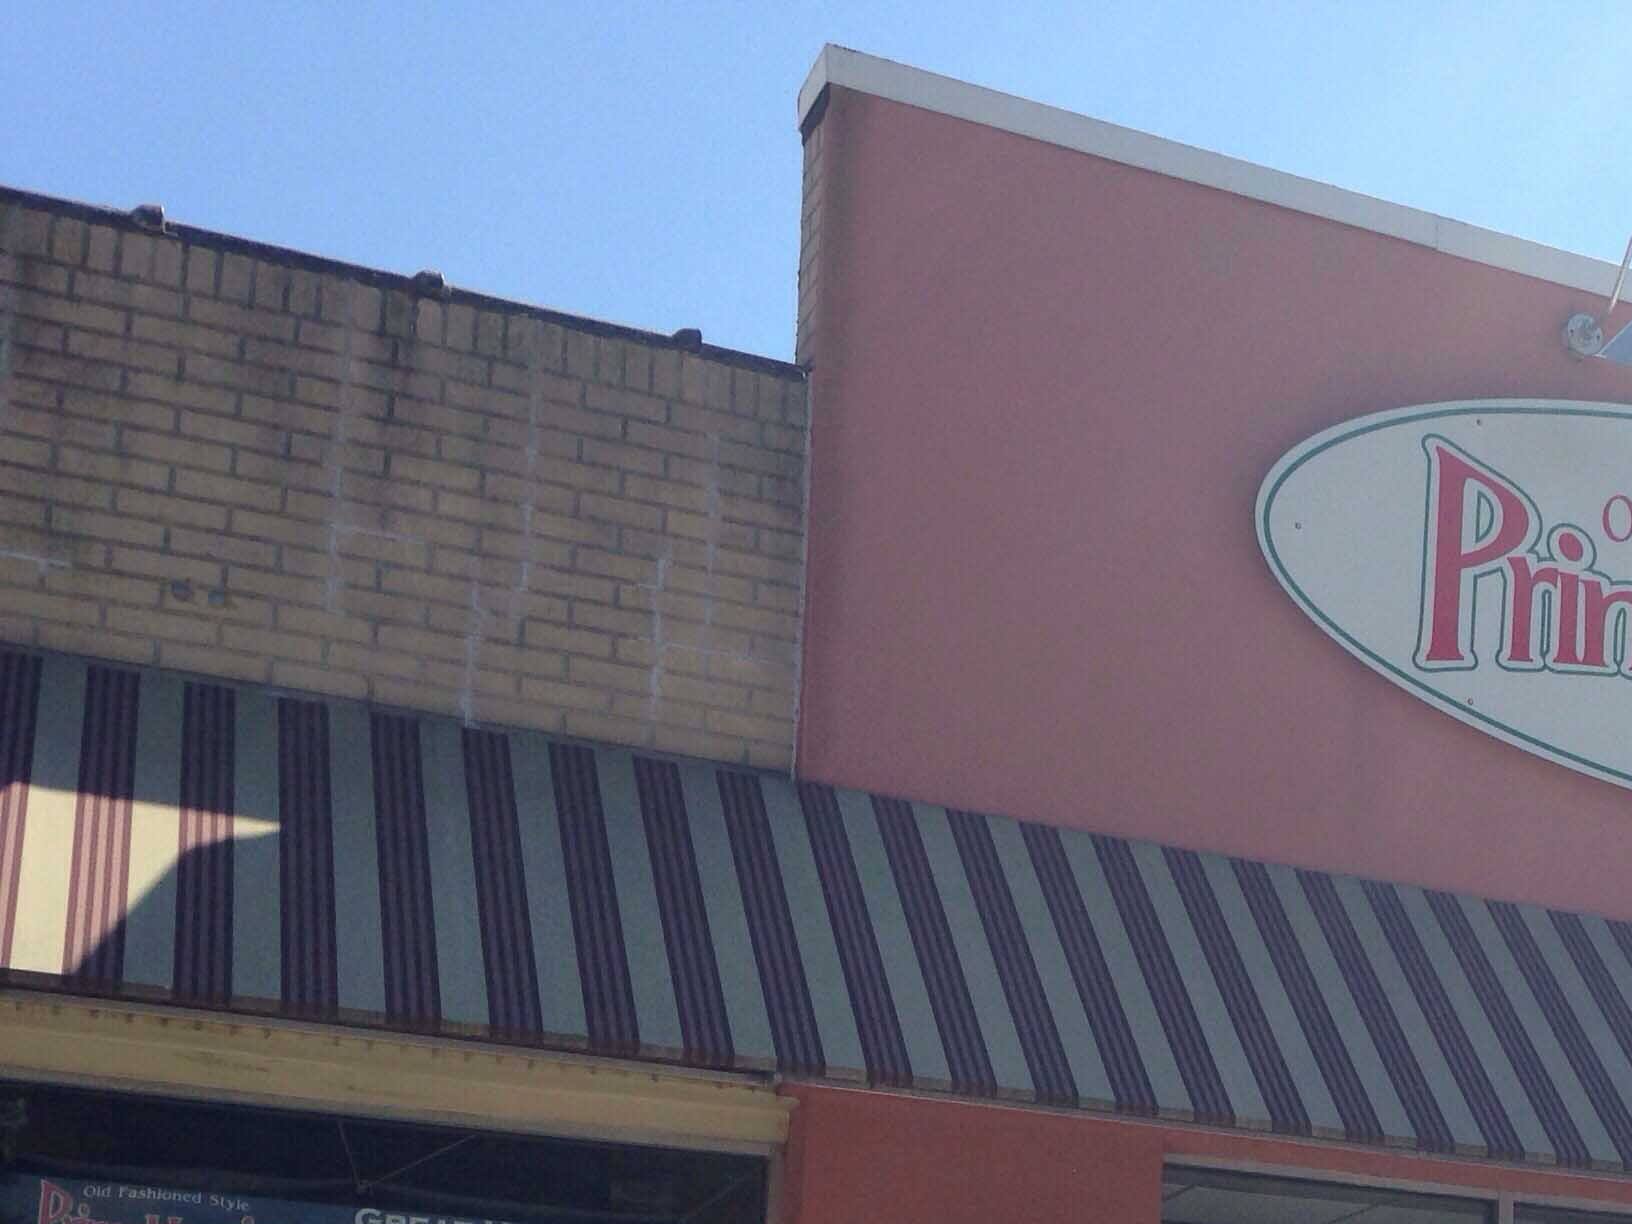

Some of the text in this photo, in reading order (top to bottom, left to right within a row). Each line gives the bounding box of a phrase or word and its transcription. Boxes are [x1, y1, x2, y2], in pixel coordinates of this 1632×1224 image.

[83, 1184, 250, 1212] Old Fashioned Style
